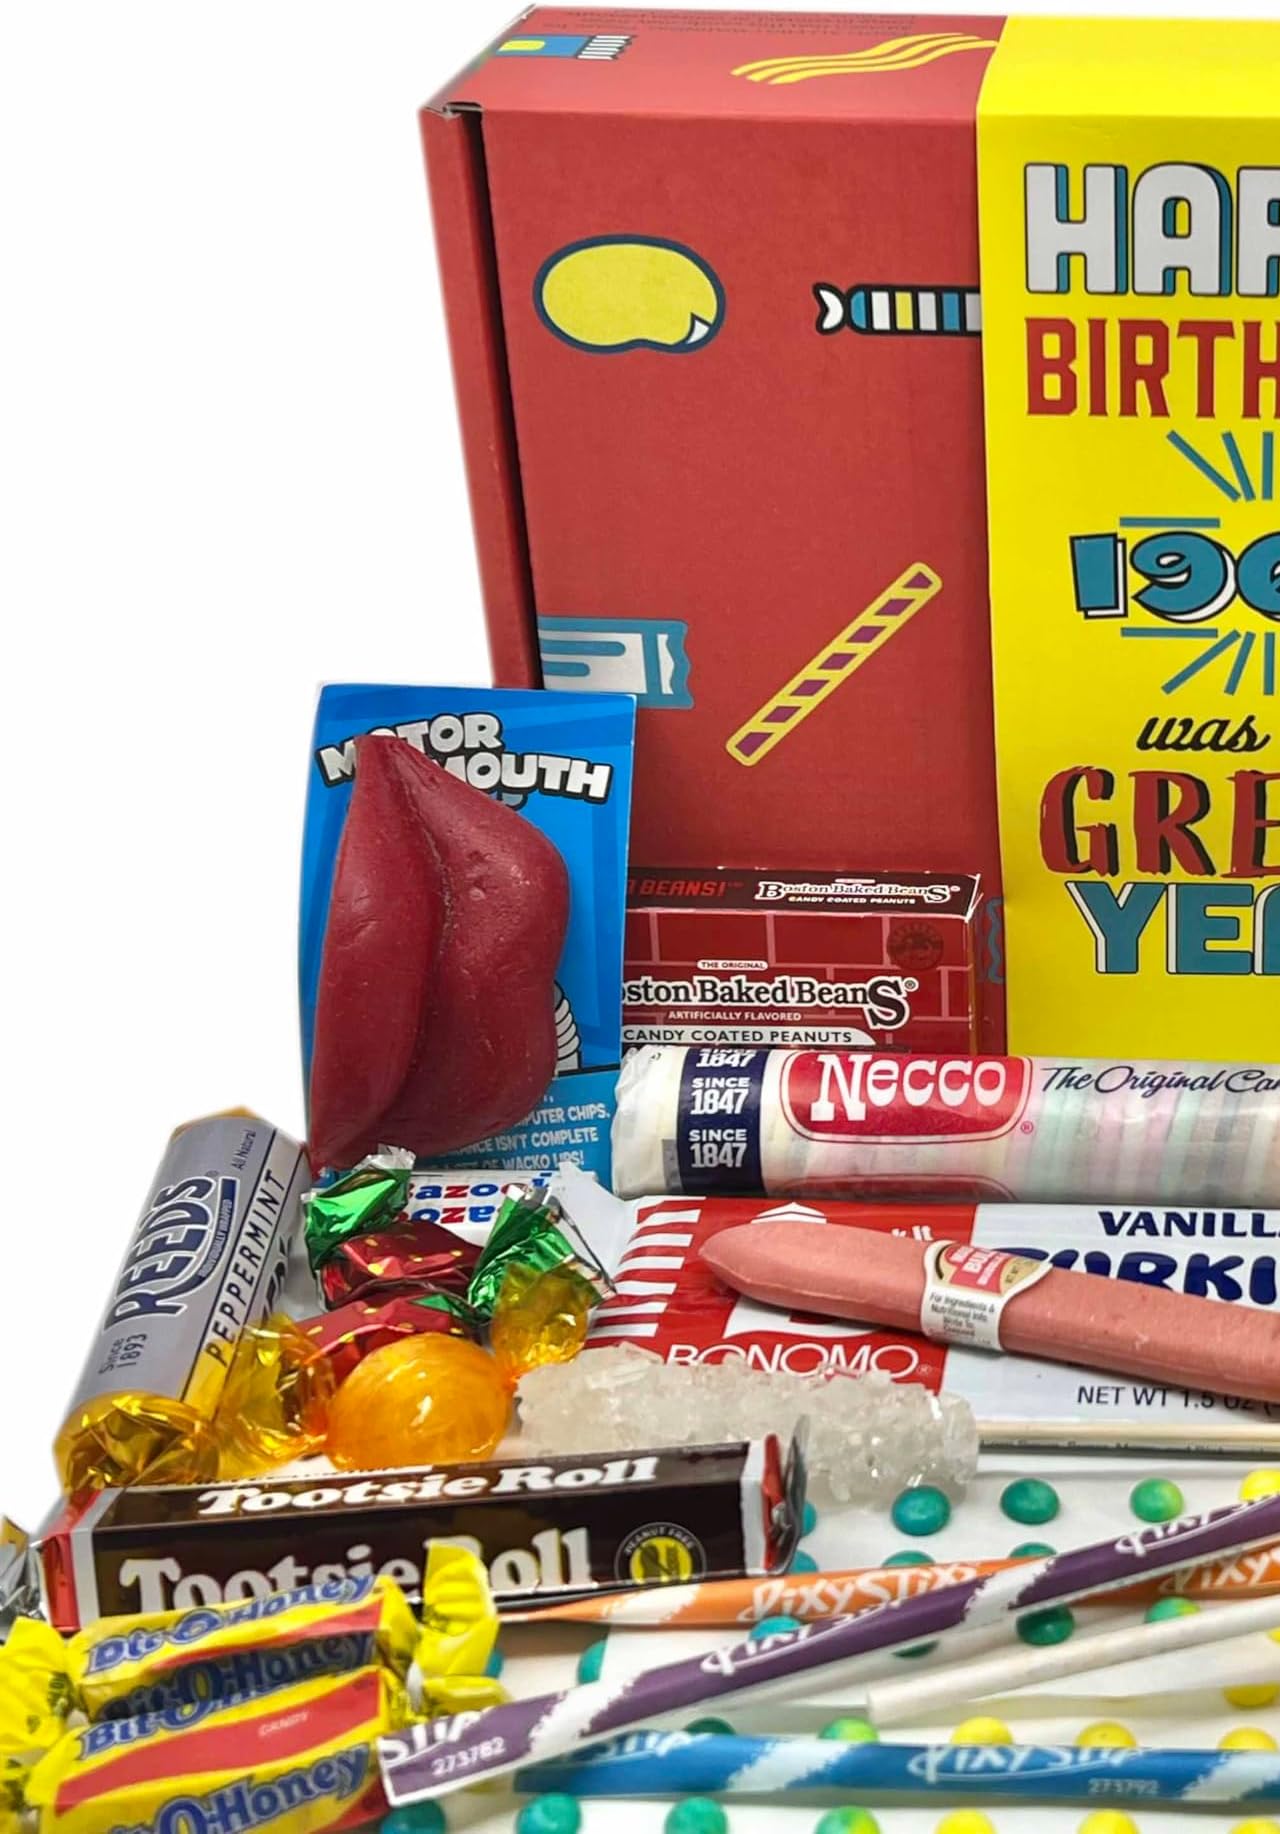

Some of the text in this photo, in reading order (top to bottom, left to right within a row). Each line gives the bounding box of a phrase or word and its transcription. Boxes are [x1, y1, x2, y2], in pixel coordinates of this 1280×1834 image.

[318, 713, 503, 781] MTOR
[1136, 713, 1270, 754] was
[788, 896, 916, 905] CANDY COATED PEANUTS
[701, 961, 766, 970] THE ORIGINAL
[622, 976, 693, 1005] ston
[696, 977, 791, 1005] Baked
[668, 1010, 802, 1022] ARTIFICIALLY FLAVORED
[623, 1029, 853, 1043] CANDY COATED PEANUTS
[696, 1050, 757, 1068] 1847
[691, 1076, 751, 1089] SINCE
[809, 1054, 1007, 1123] Necco
[1042, 1065, 1095, 1093] The
[1094, 1065, 1225, 1098] Original
[567, 1103, 611, 1121] CHIPS.
[689, 1088, 749, 1115] 1847
[495, 1133, 528, 1151] ISN'T
[531, 1126, 599, 1148] COMPLETE
[688, 1128, 748, 1142] SINCE
[501, 1154, 551, 1170] WACKO
[689, 1142, 748, 1168] 1847
[103, 1175, 214, 1331] REEDS
[204, 1168, 287, 1368] PEPPERMINT
[98, 1337, 125, 1375] Since
[117, 1332, 148, 1367] 1893
[1077, 1385, 1126, 1406] NET
[1133, 1386, 1170, 1407] WT
[1182, 1389, 1215, 1409] 1.5
[197, 1455, 659, 1516] Tootsie Roll
[424, 1528, 593, 1599] oll
[257, 1711, 311, 1738] CANDY
